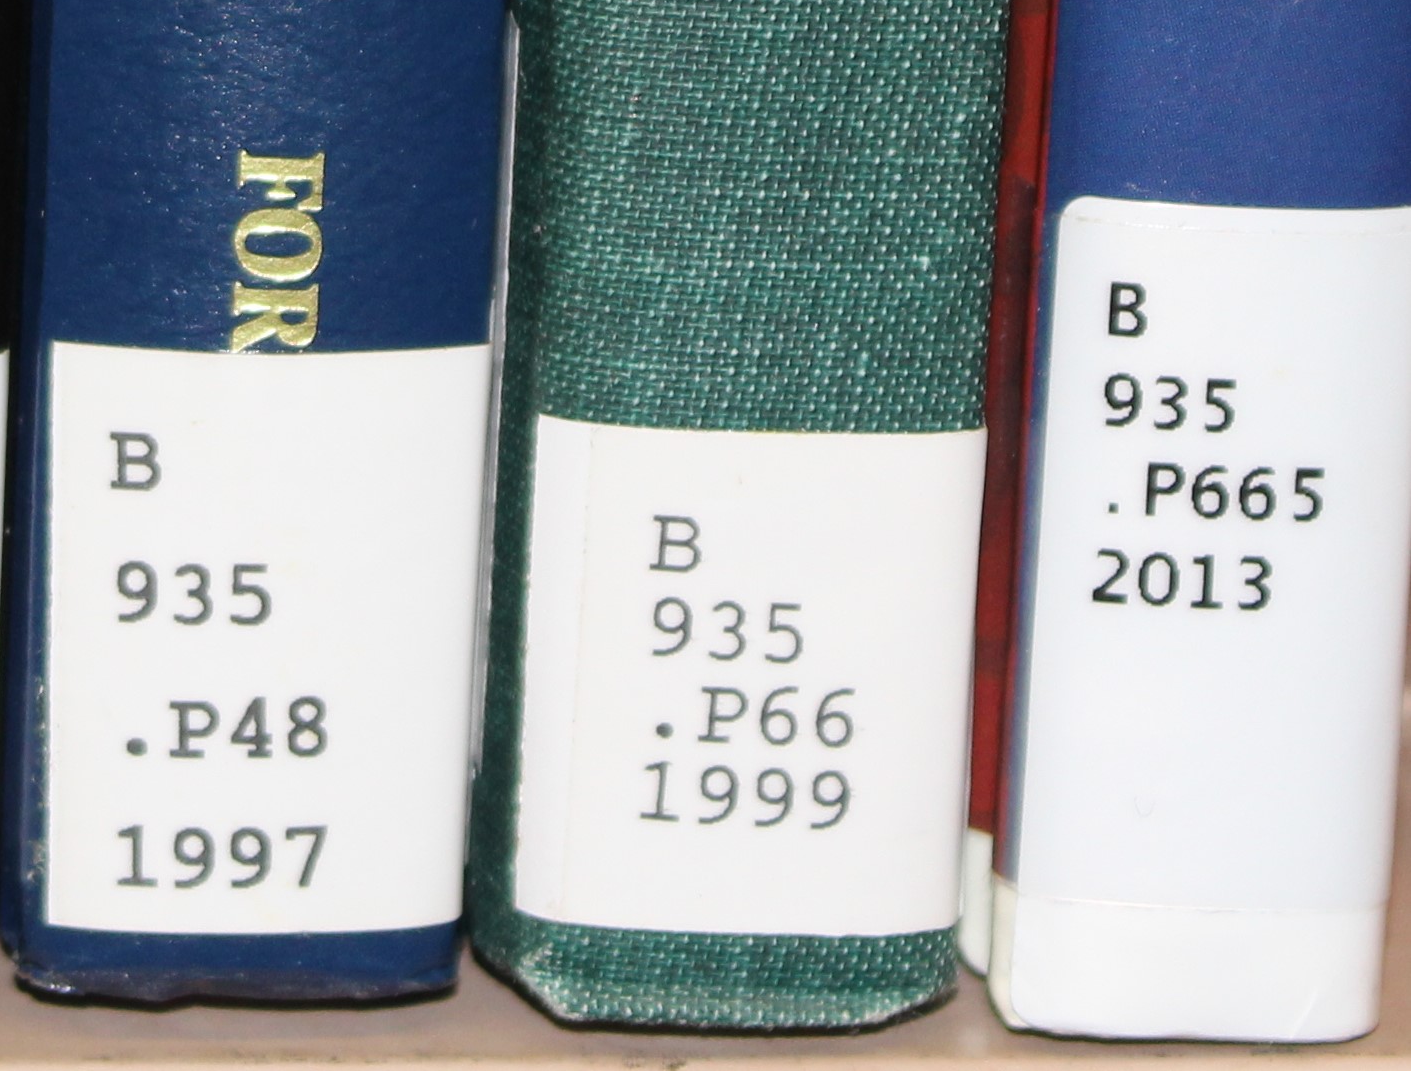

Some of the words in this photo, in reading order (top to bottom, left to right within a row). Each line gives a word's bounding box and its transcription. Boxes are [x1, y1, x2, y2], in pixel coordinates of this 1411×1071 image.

[230, 149, 325, 353] FOR
[1107, 281, 1147, 338] B
[1103, 372, 1236, 433] 935
[109, 431, 159, 491] B
[1108, 462, 1325, 523] .P665
[649, 515, 700, 573] B
[116, 561, 271, 626] 935
[1091, 548, 1272, 611] 2013
[652, 597, 802, 664] 935
[126, 696, 326, 759] .P48
[655, 686, 853, 748] .P66
[640, 761, 850, 829] 1999
[117, 825, 325, 889] 1997
